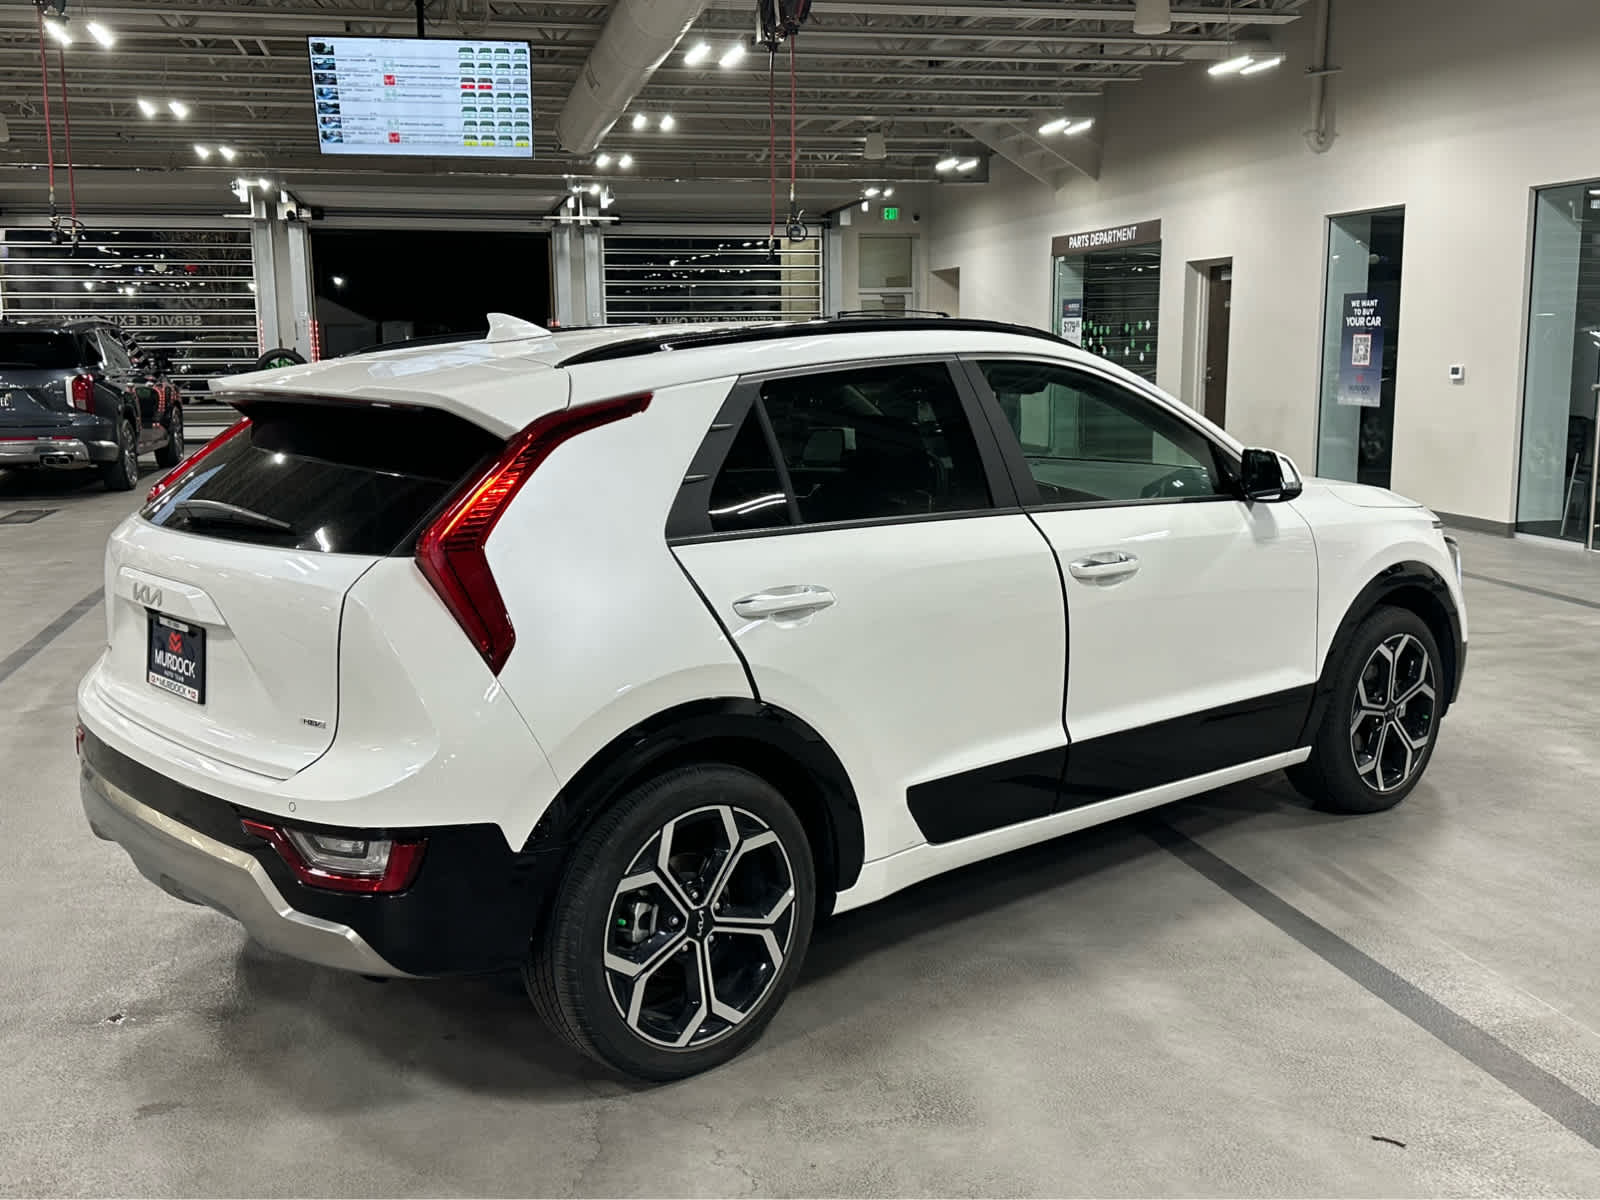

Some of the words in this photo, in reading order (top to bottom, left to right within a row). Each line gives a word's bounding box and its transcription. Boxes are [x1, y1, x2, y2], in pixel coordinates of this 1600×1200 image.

[1068, 235, 1089, 249] PARTS
[1089, 226, 1137, 246] DEPARTMENT
[1351, 299, 1361, 308] WE
[1361, 299, 1378, 307] WANT
[1354, 308, 1362, 316] TO
[1362, 308, 1374, 316] BUY
[1346, 316, 1365, 327] YOUR
[1366, 316, 1382, 327] CAR
[133, 582, 162, 607] KIA
[154, 648, 196, 679] MURDOCK
